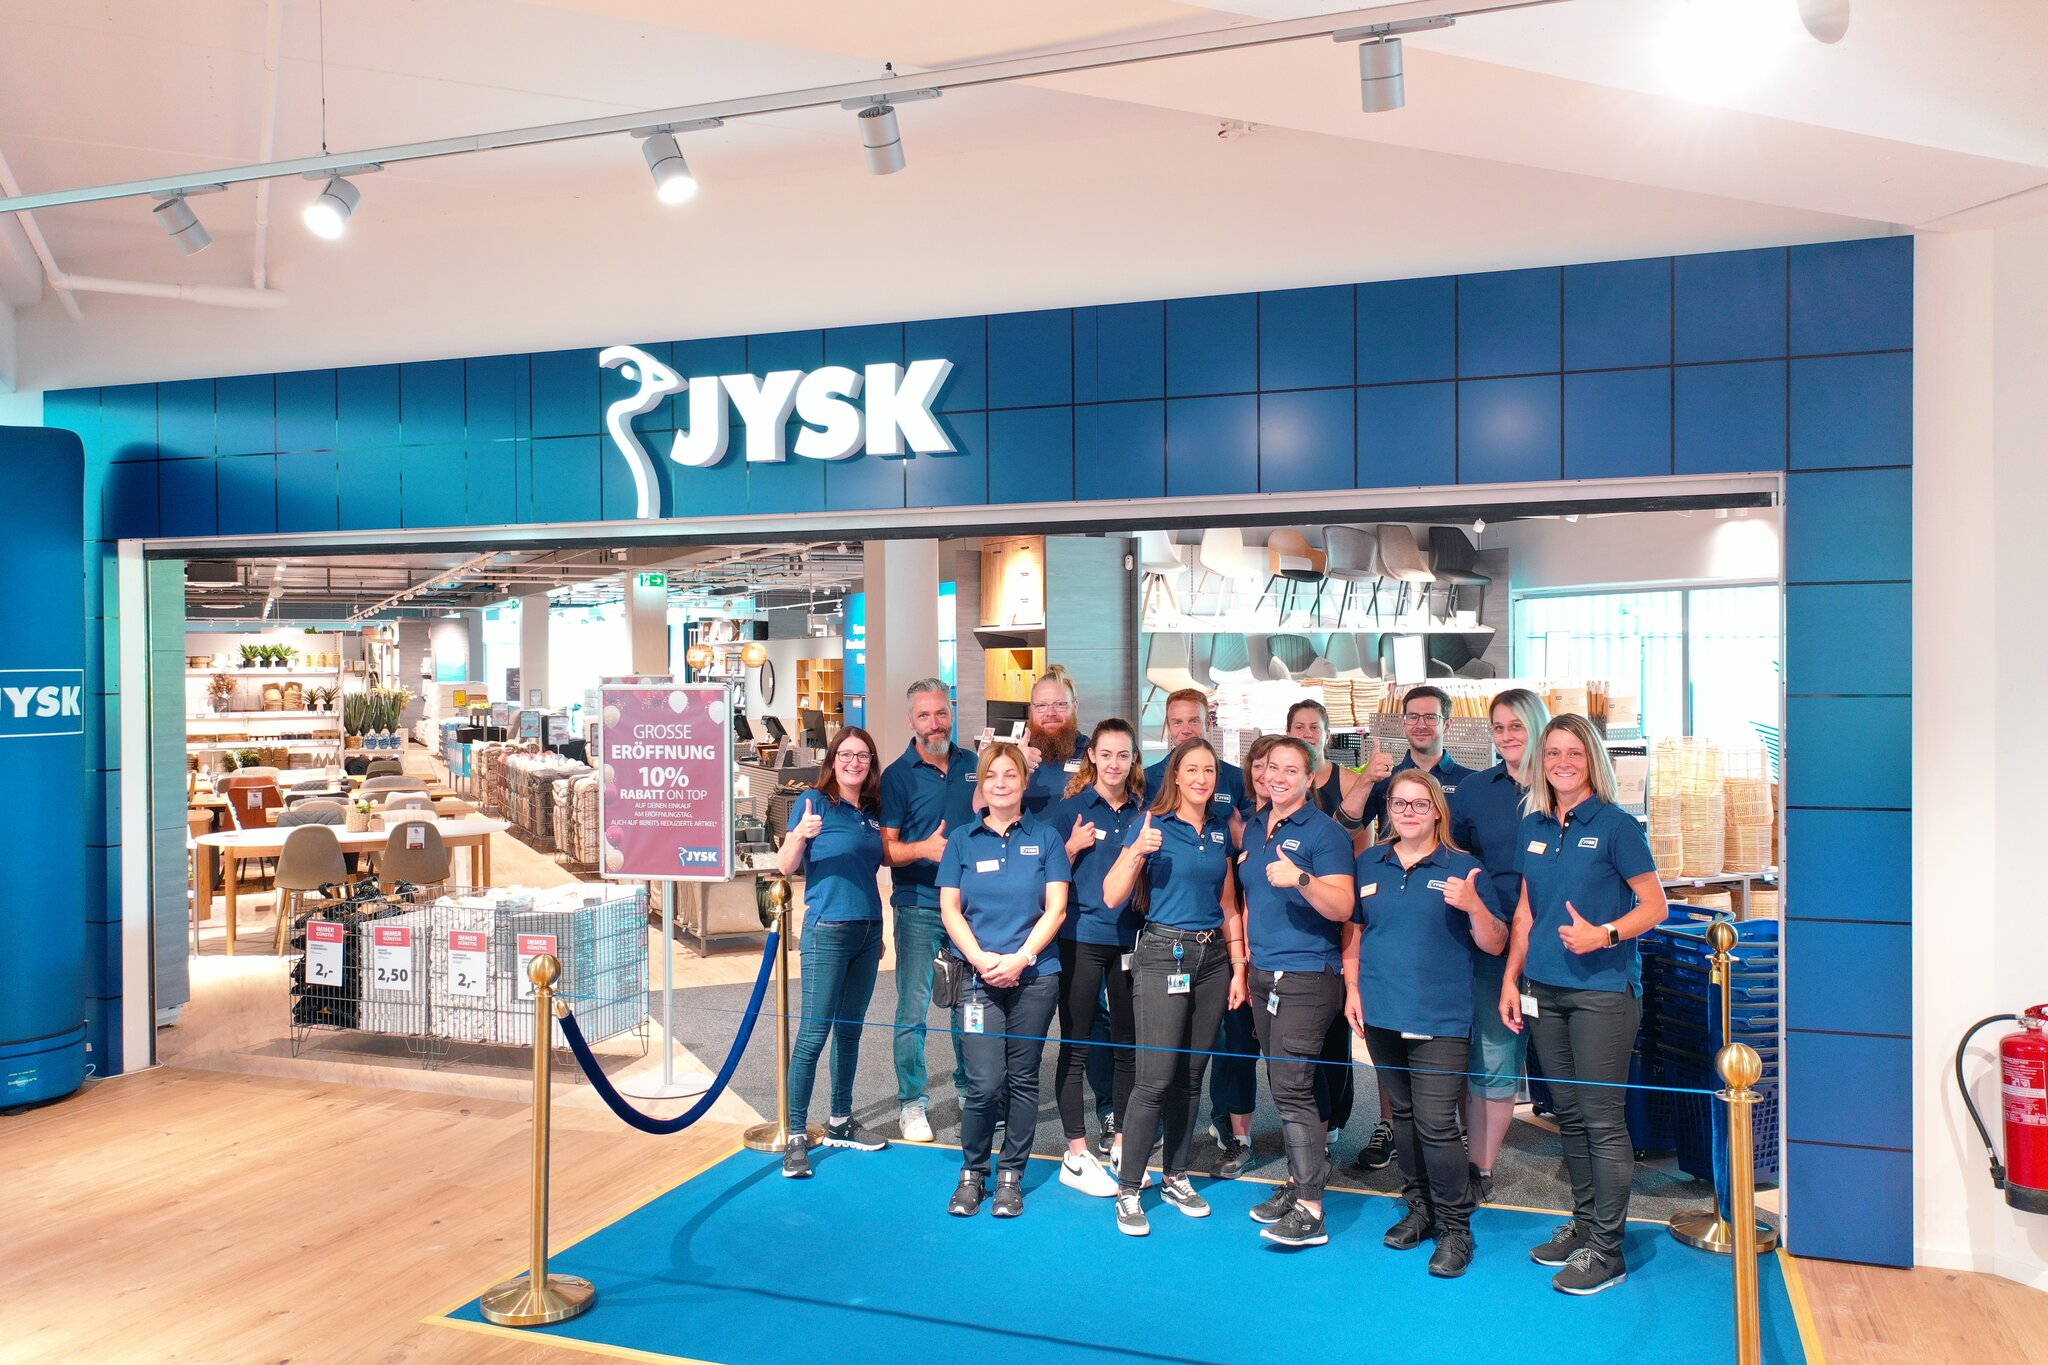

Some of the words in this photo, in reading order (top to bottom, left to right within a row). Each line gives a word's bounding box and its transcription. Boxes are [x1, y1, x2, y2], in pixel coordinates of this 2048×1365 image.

[670, 359, 957, 467] JYSK
[0, 686, 81, 718] YSK
[633, 724, 692, 739] GROSSE
[611, 741, 716, 760] ERÖFFNUNG
[638, 766, 690, 787] 10%
[620, 789, 665, 799] RABATT
[666, 789, 684, 800] ON
[685, 789, 708, 800] TOP
[686, 851, 718, 862] JYSK
[315, 962, 334, 979] 2,-
[377, 967, 408, 983] 2,50
[457, 973, 477, 989] 2,-
